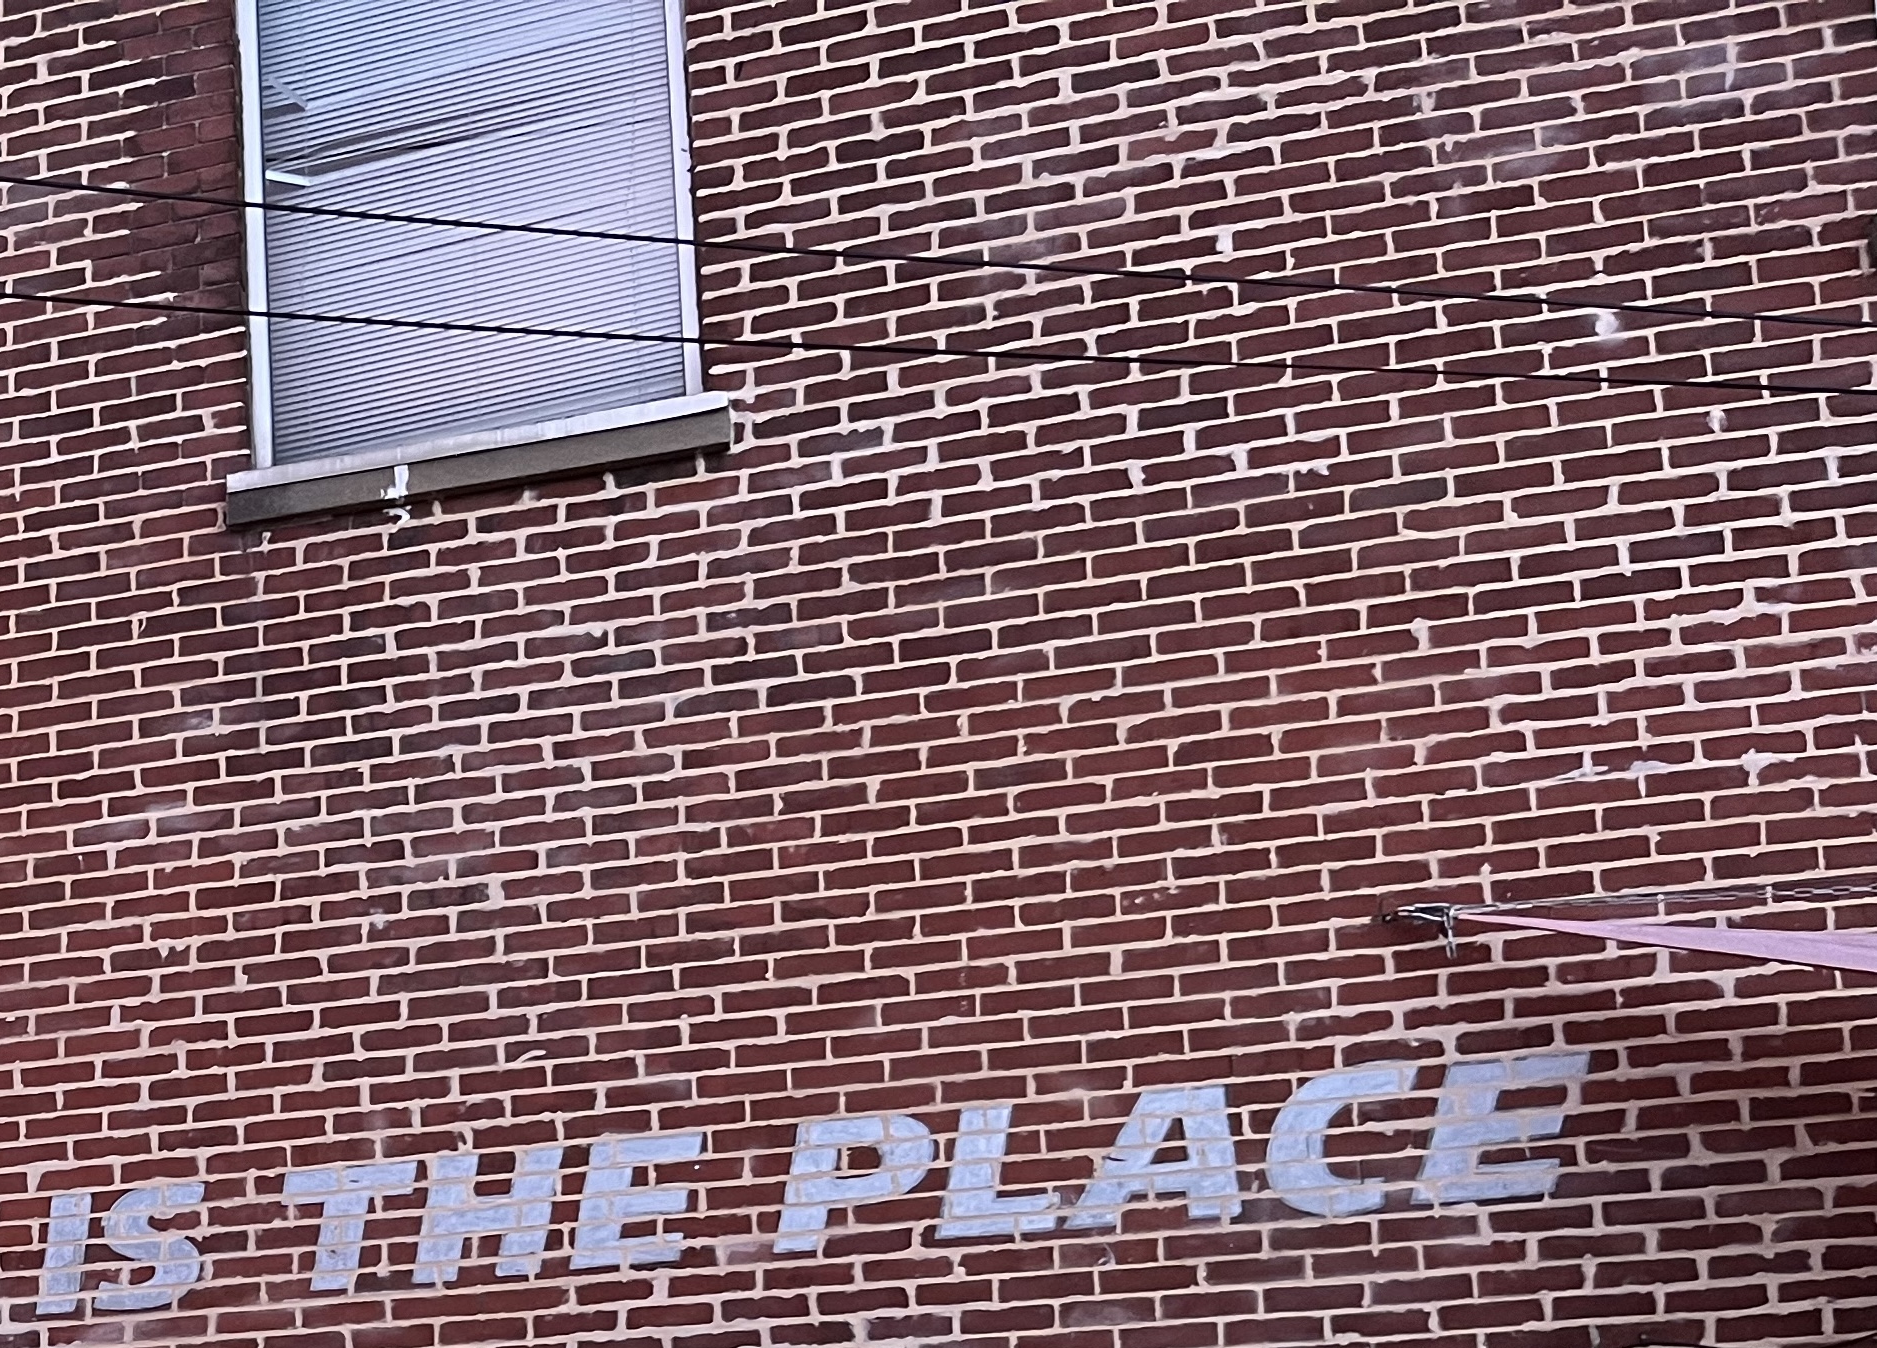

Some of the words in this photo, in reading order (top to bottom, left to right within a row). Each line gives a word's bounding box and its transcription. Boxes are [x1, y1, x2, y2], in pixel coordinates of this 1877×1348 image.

[35, 1182, 206, 1315] IS
[281, 1132, 703, 1292] THE
[773, 1050, 1591, 1254] PLACE
